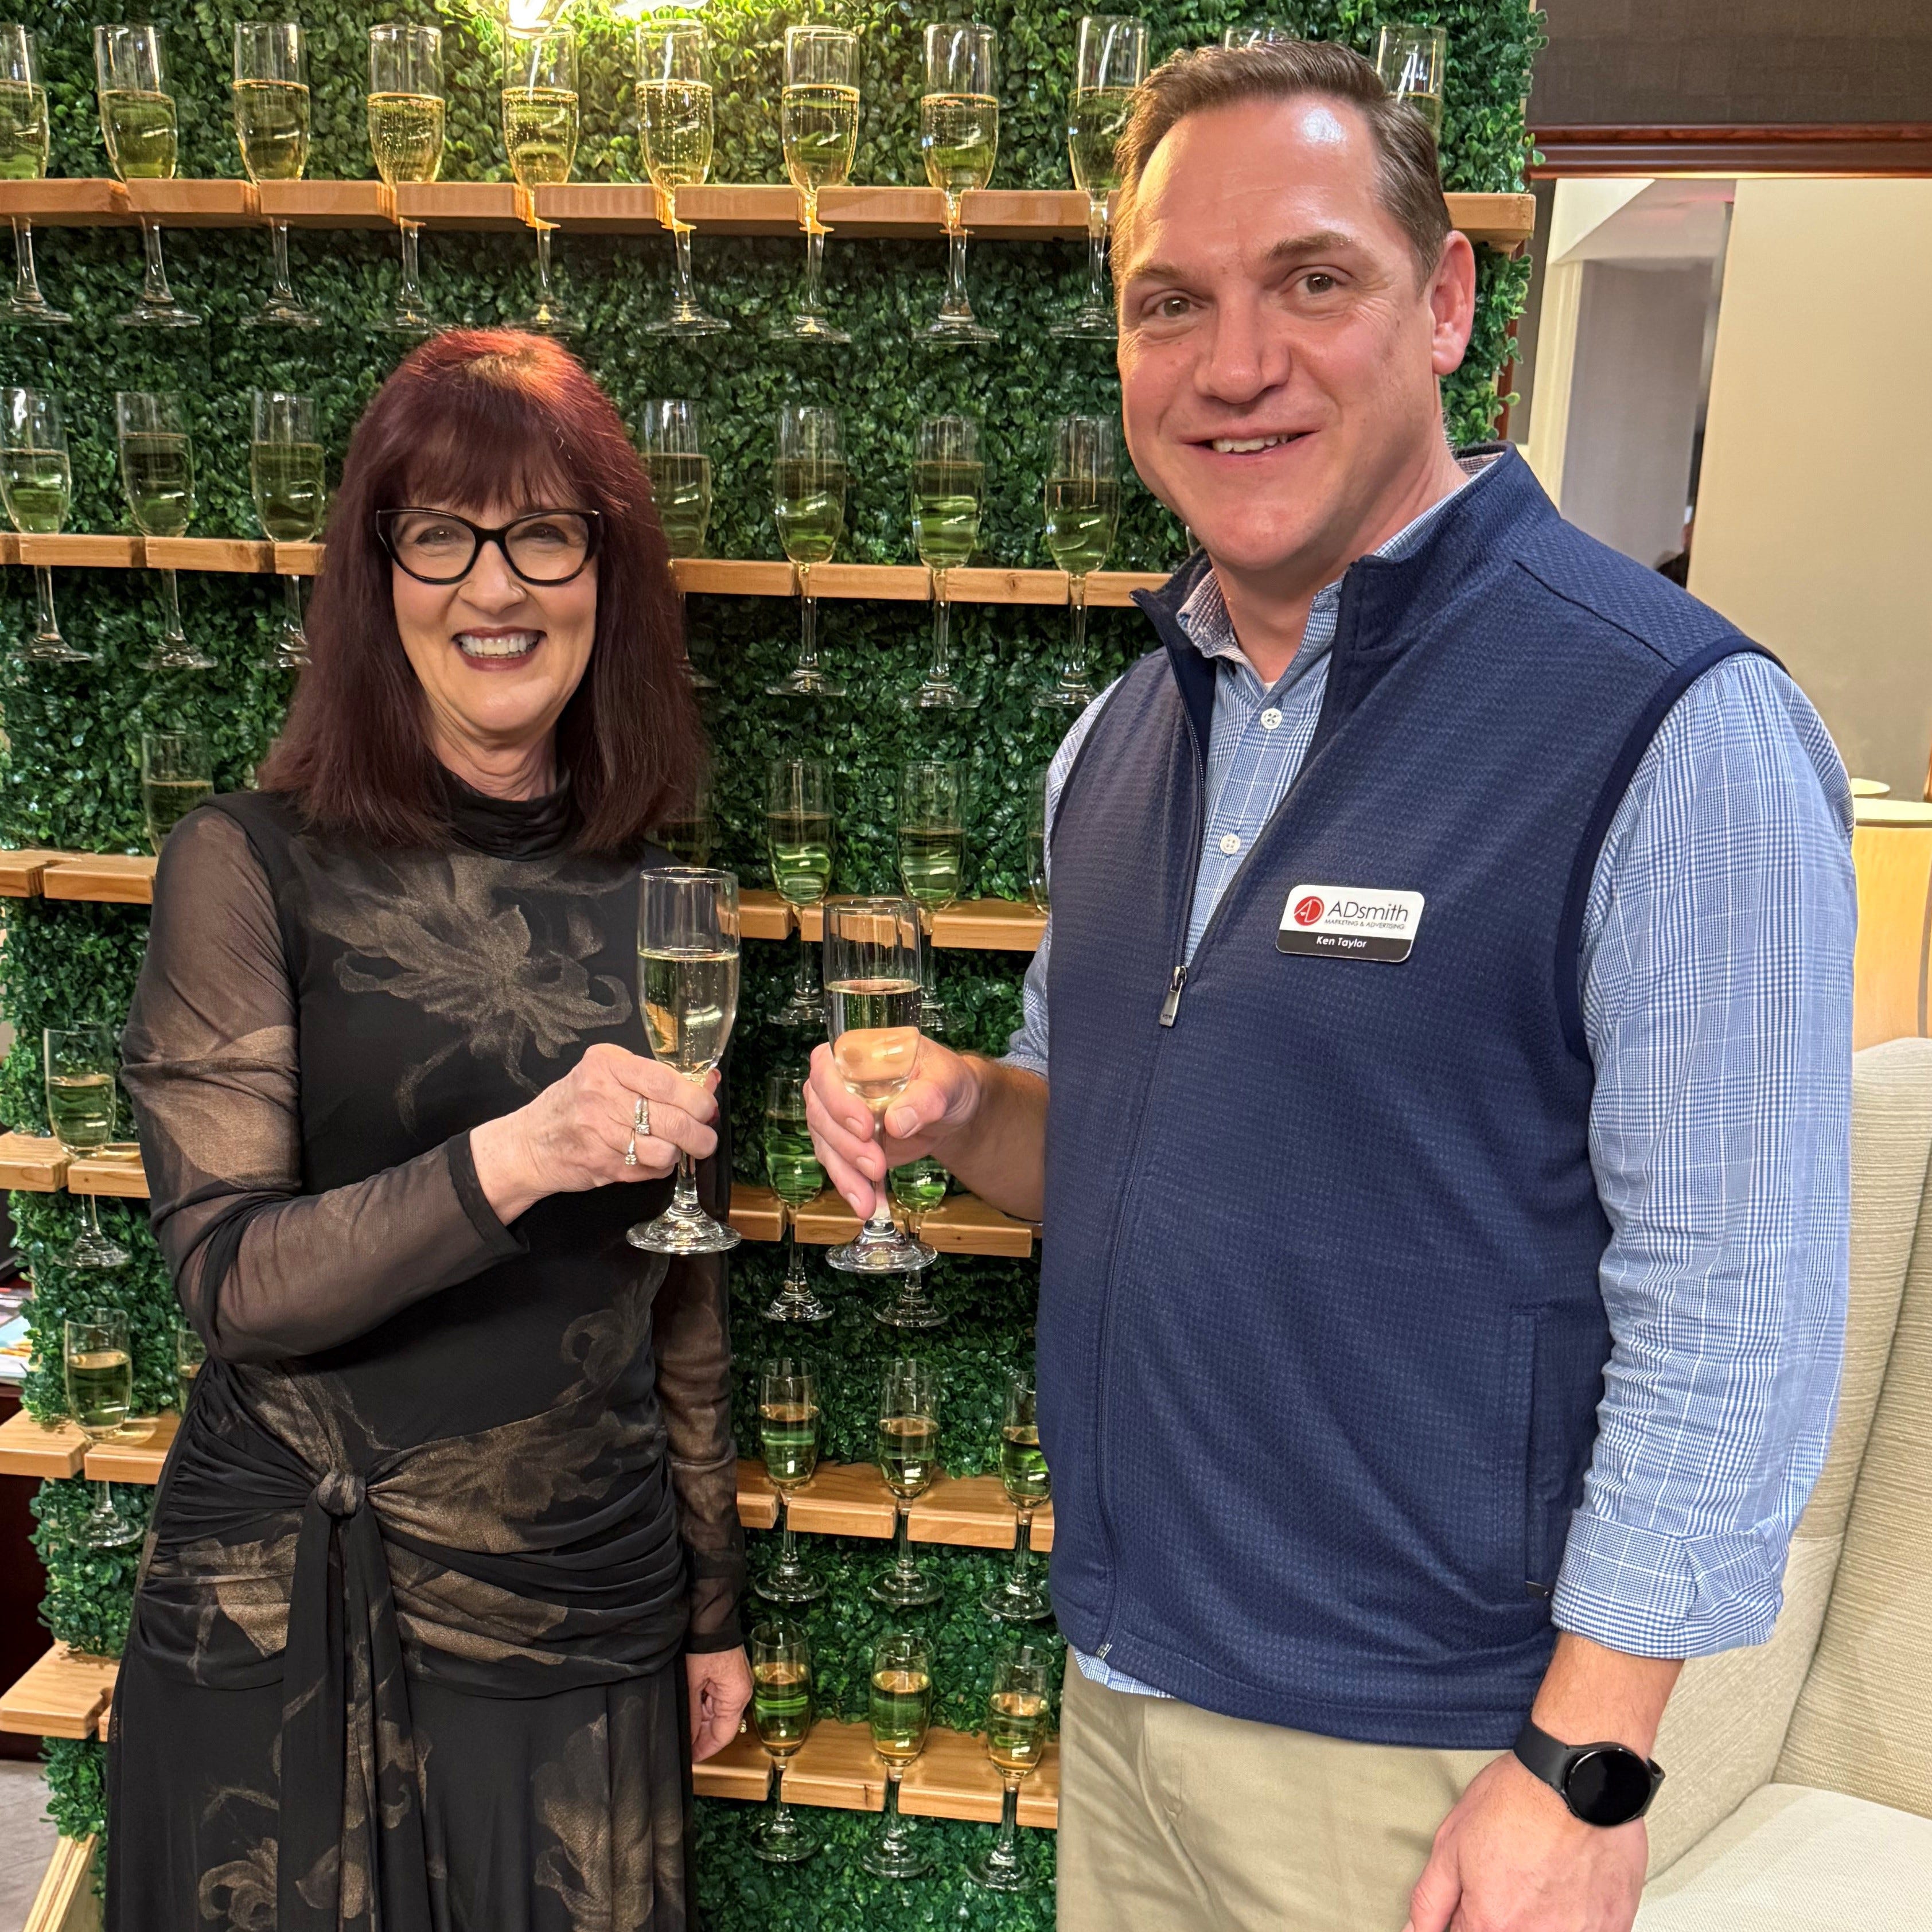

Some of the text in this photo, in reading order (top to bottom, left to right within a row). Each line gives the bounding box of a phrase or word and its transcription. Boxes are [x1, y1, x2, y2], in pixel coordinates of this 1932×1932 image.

[1327, 901, 1408, 922] ADsmith
[1316, 936, 1367, 949] Ken Taylor
